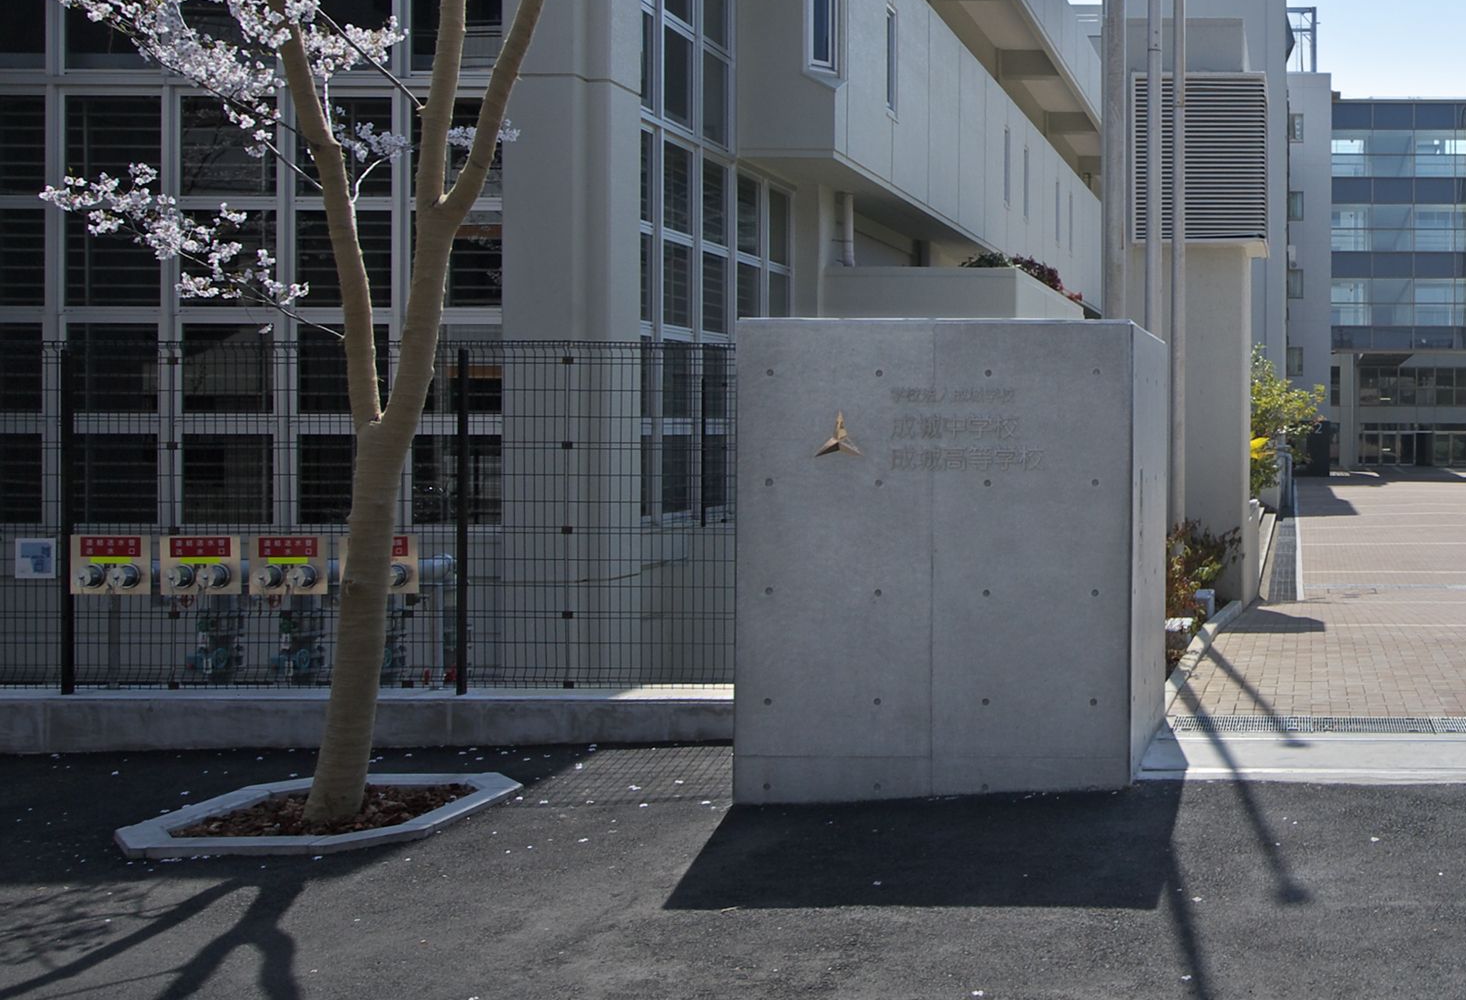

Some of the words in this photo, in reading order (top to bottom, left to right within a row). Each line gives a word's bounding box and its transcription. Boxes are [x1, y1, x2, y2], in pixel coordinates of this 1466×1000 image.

[891, 414, 1019, 440] 成城中学校
[891, 446, 1046, 472] 成城高等学校
